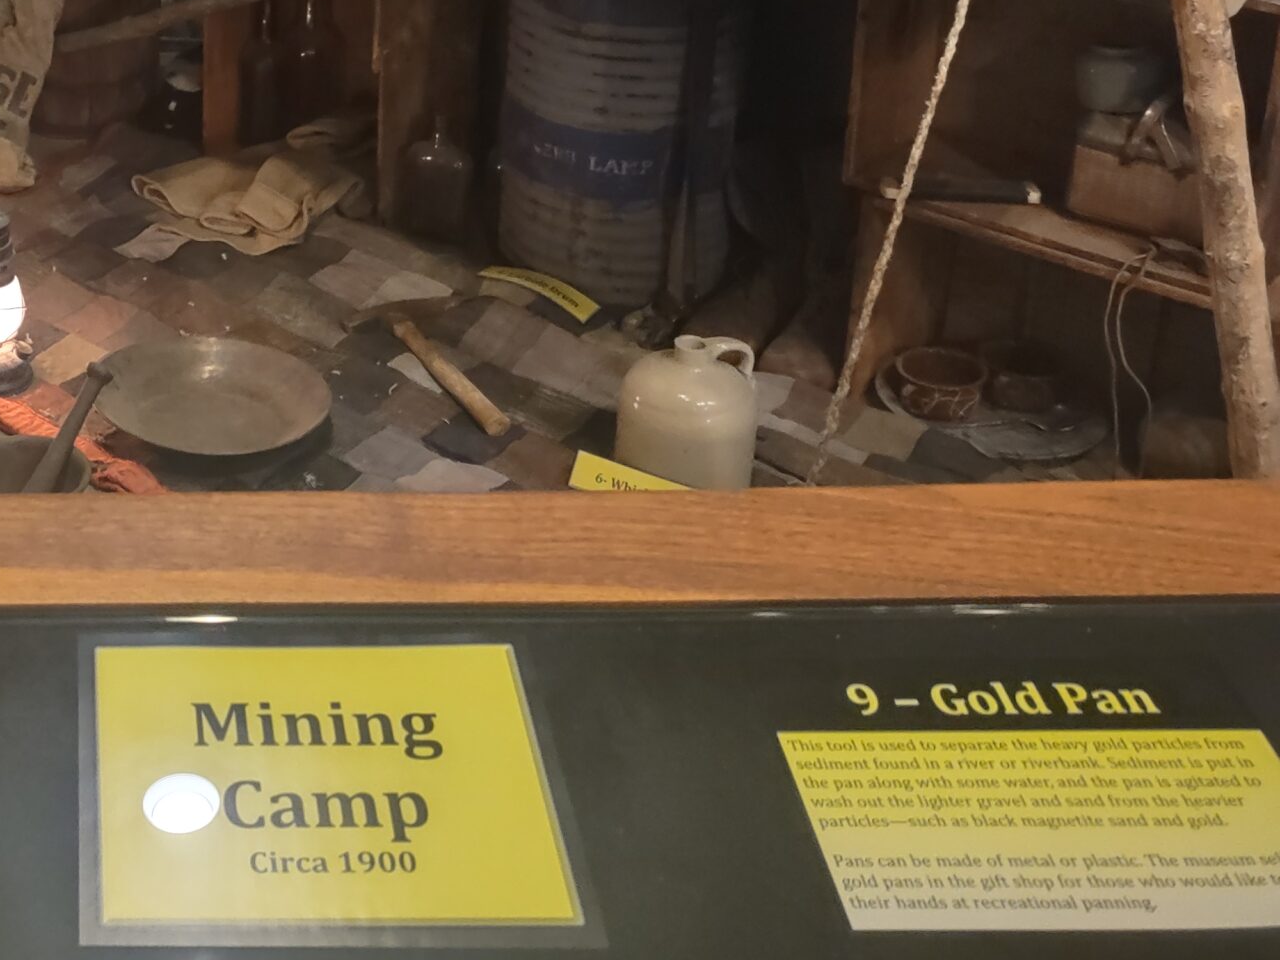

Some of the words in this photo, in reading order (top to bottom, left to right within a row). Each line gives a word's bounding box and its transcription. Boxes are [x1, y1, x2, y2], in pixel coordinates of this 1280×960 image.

[845, 682, 880, 716] 9
[930, 680, 1053, 716] Gold
[1051, 681, 1163, 715] Pan
[192, 701, 445, 761] Mining
[786, 740, 823, 751] This
[825, 740, 858, 751] tool
[860, 741, 875, 751] is
[877, 739, 917, 751] used
[918, 740, 936, 750] to
[939, 740, 1008, 753] separate
[1010, 739, 1038, 750] the
[1038, 739, 1087, 752] heavy
[1091, 738, 1128, 752] gold
[1130, 738, 1202, 752] particles
[1202, 738, 1245, 749] from
[795, 758, 871, 770] sediment
[872, 758, 921, 769] found
[922, 759, 940, 769] in
[943, 761, 954, 769] a
[956, 759, 994, 769] river
[999, 761, 1016, 769] or
[1105, 757, 1186, 768] Sediment
[1186, 758, 1203, 768] is
[1204, 757, 1235, 771] put
[1235, 757, 1255, 768] in
[802, 777, 828, 789] the
[832, 780, 864, 791] pan
[866, 777, 914, 791] along
[914, 776, 953, 788] with
[955, 779, 1000, 788] some
[1055, 776, 1088, 788] and
[1089, 776, 1118, 787] the
[1121, 779, 1154, 790] pan
[1154, 777, 1172, 787] is
[1174, 775, 1242, 790] agitated
[1242, 776, 1261, 787] to
[809, 796, 853, 808] wash
[856, 797, 885, 808] out
[886, 796, 914, 808] the
[915, 795, 972, 810] lighter
[975, 795, 1027, 810] gravel
[1029, 795, 1062, 807] and
[1064, 795, 1106, 807] sand
[1106, 795, 1149, 807] from
[1150, 795, 1180, 806] the
[1180, 794, 1243, 806] heavier
[223, 779, 429, 842] Camp
[817, 815, 947, 831] particles—such
[950, 818, 969, 827] as
[969, 815, 1018, 827] black
[1020, 816, 1104, 830] magnetite
[1107, 814, 1149, 826] sand
[1151, 814, 1184, 826] and
[250, 850, 329, 875] Circa
[340, 850, 417, 874] 1900
[848, 895, 890, 909] their
[893, 895, 948, 909] hands
[951, 896, 970, 908] at
[971, 894, 1078, 908] recreational
